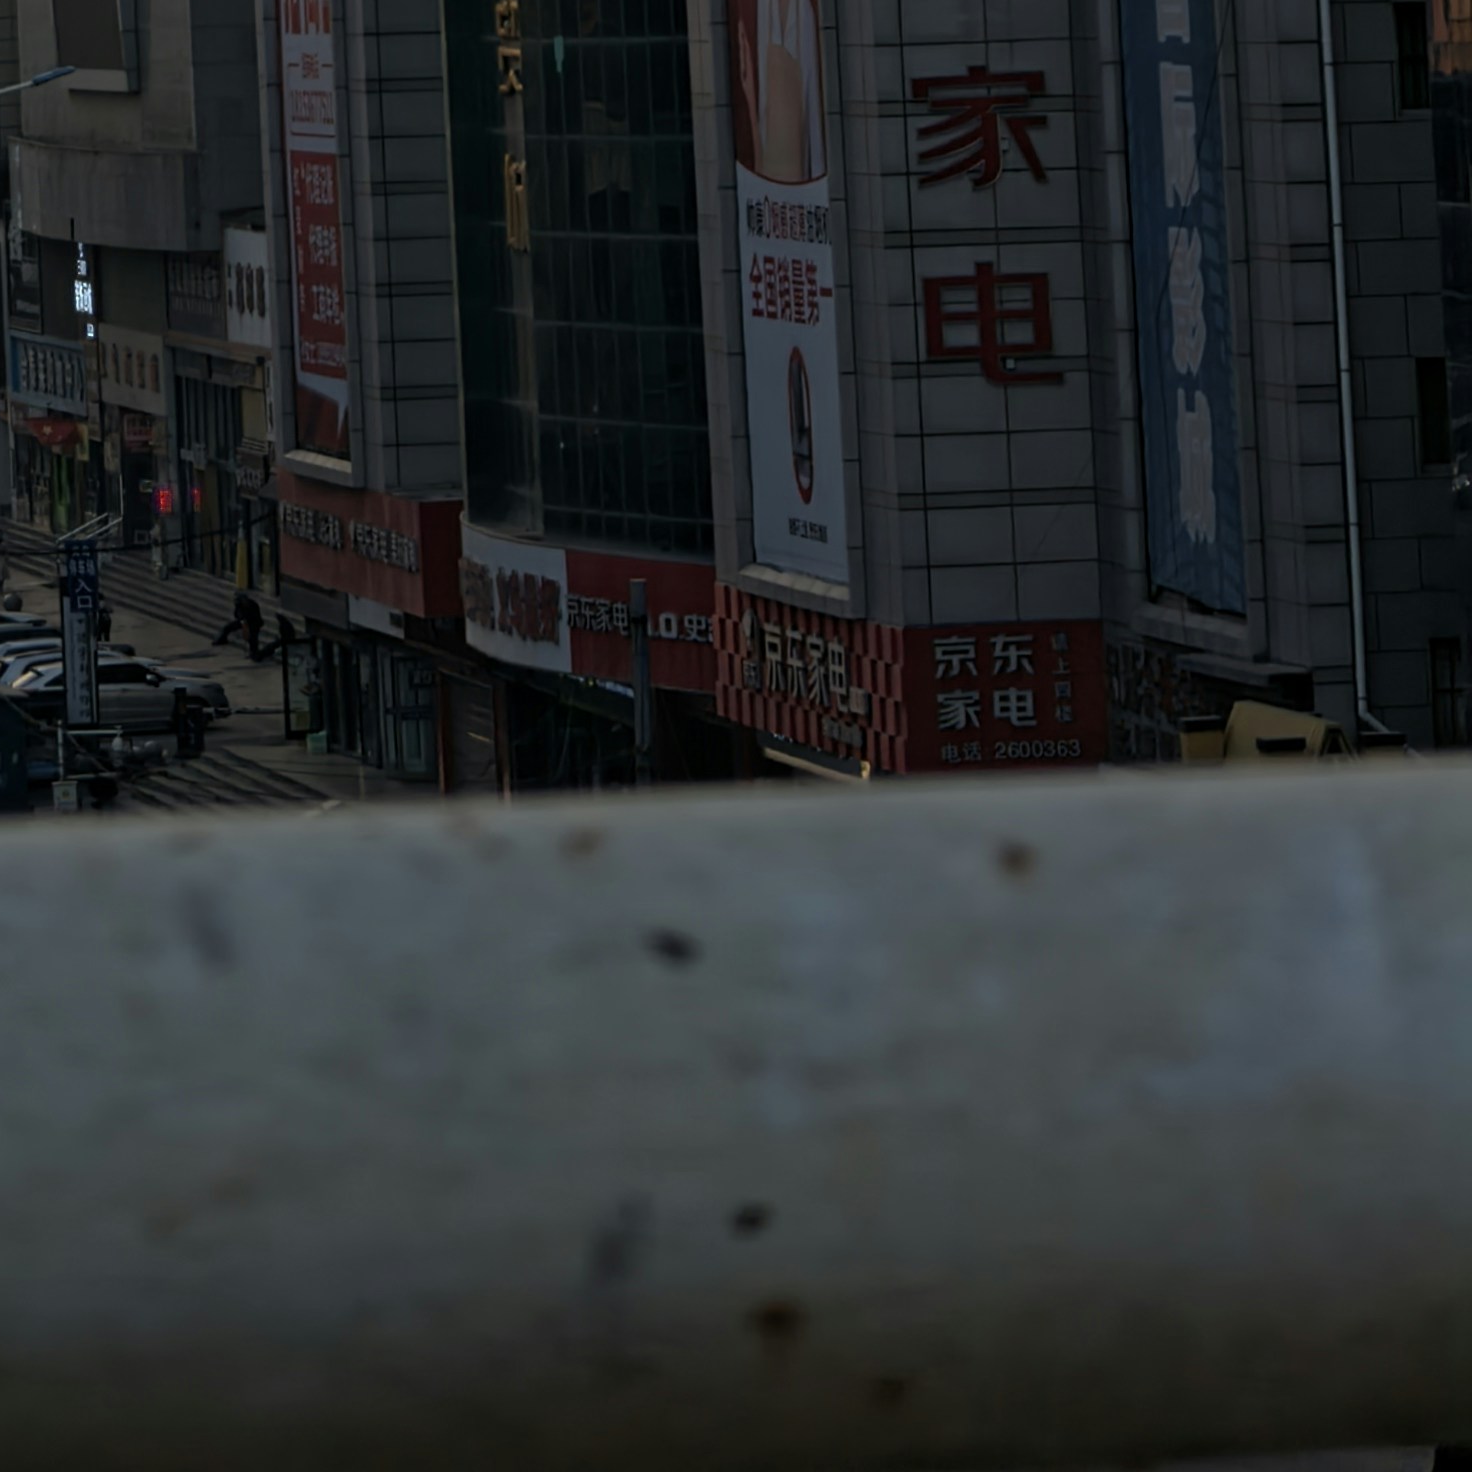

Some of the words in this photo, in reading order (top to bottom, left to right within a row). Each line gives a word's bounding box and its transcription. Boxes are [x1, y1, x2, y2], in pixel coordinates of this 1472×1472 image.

[75, 578, 93, 608] 入口
[567, 593, 631, 636] 京东家电
[761, 622, 848, 713] 京东家电
[932, 632, 1036, 680] 京东
[936, 687, 1038, 732] 家电
[940, 743, 983, 764] 电话
[994, 739, 1082, 761] 2600363
